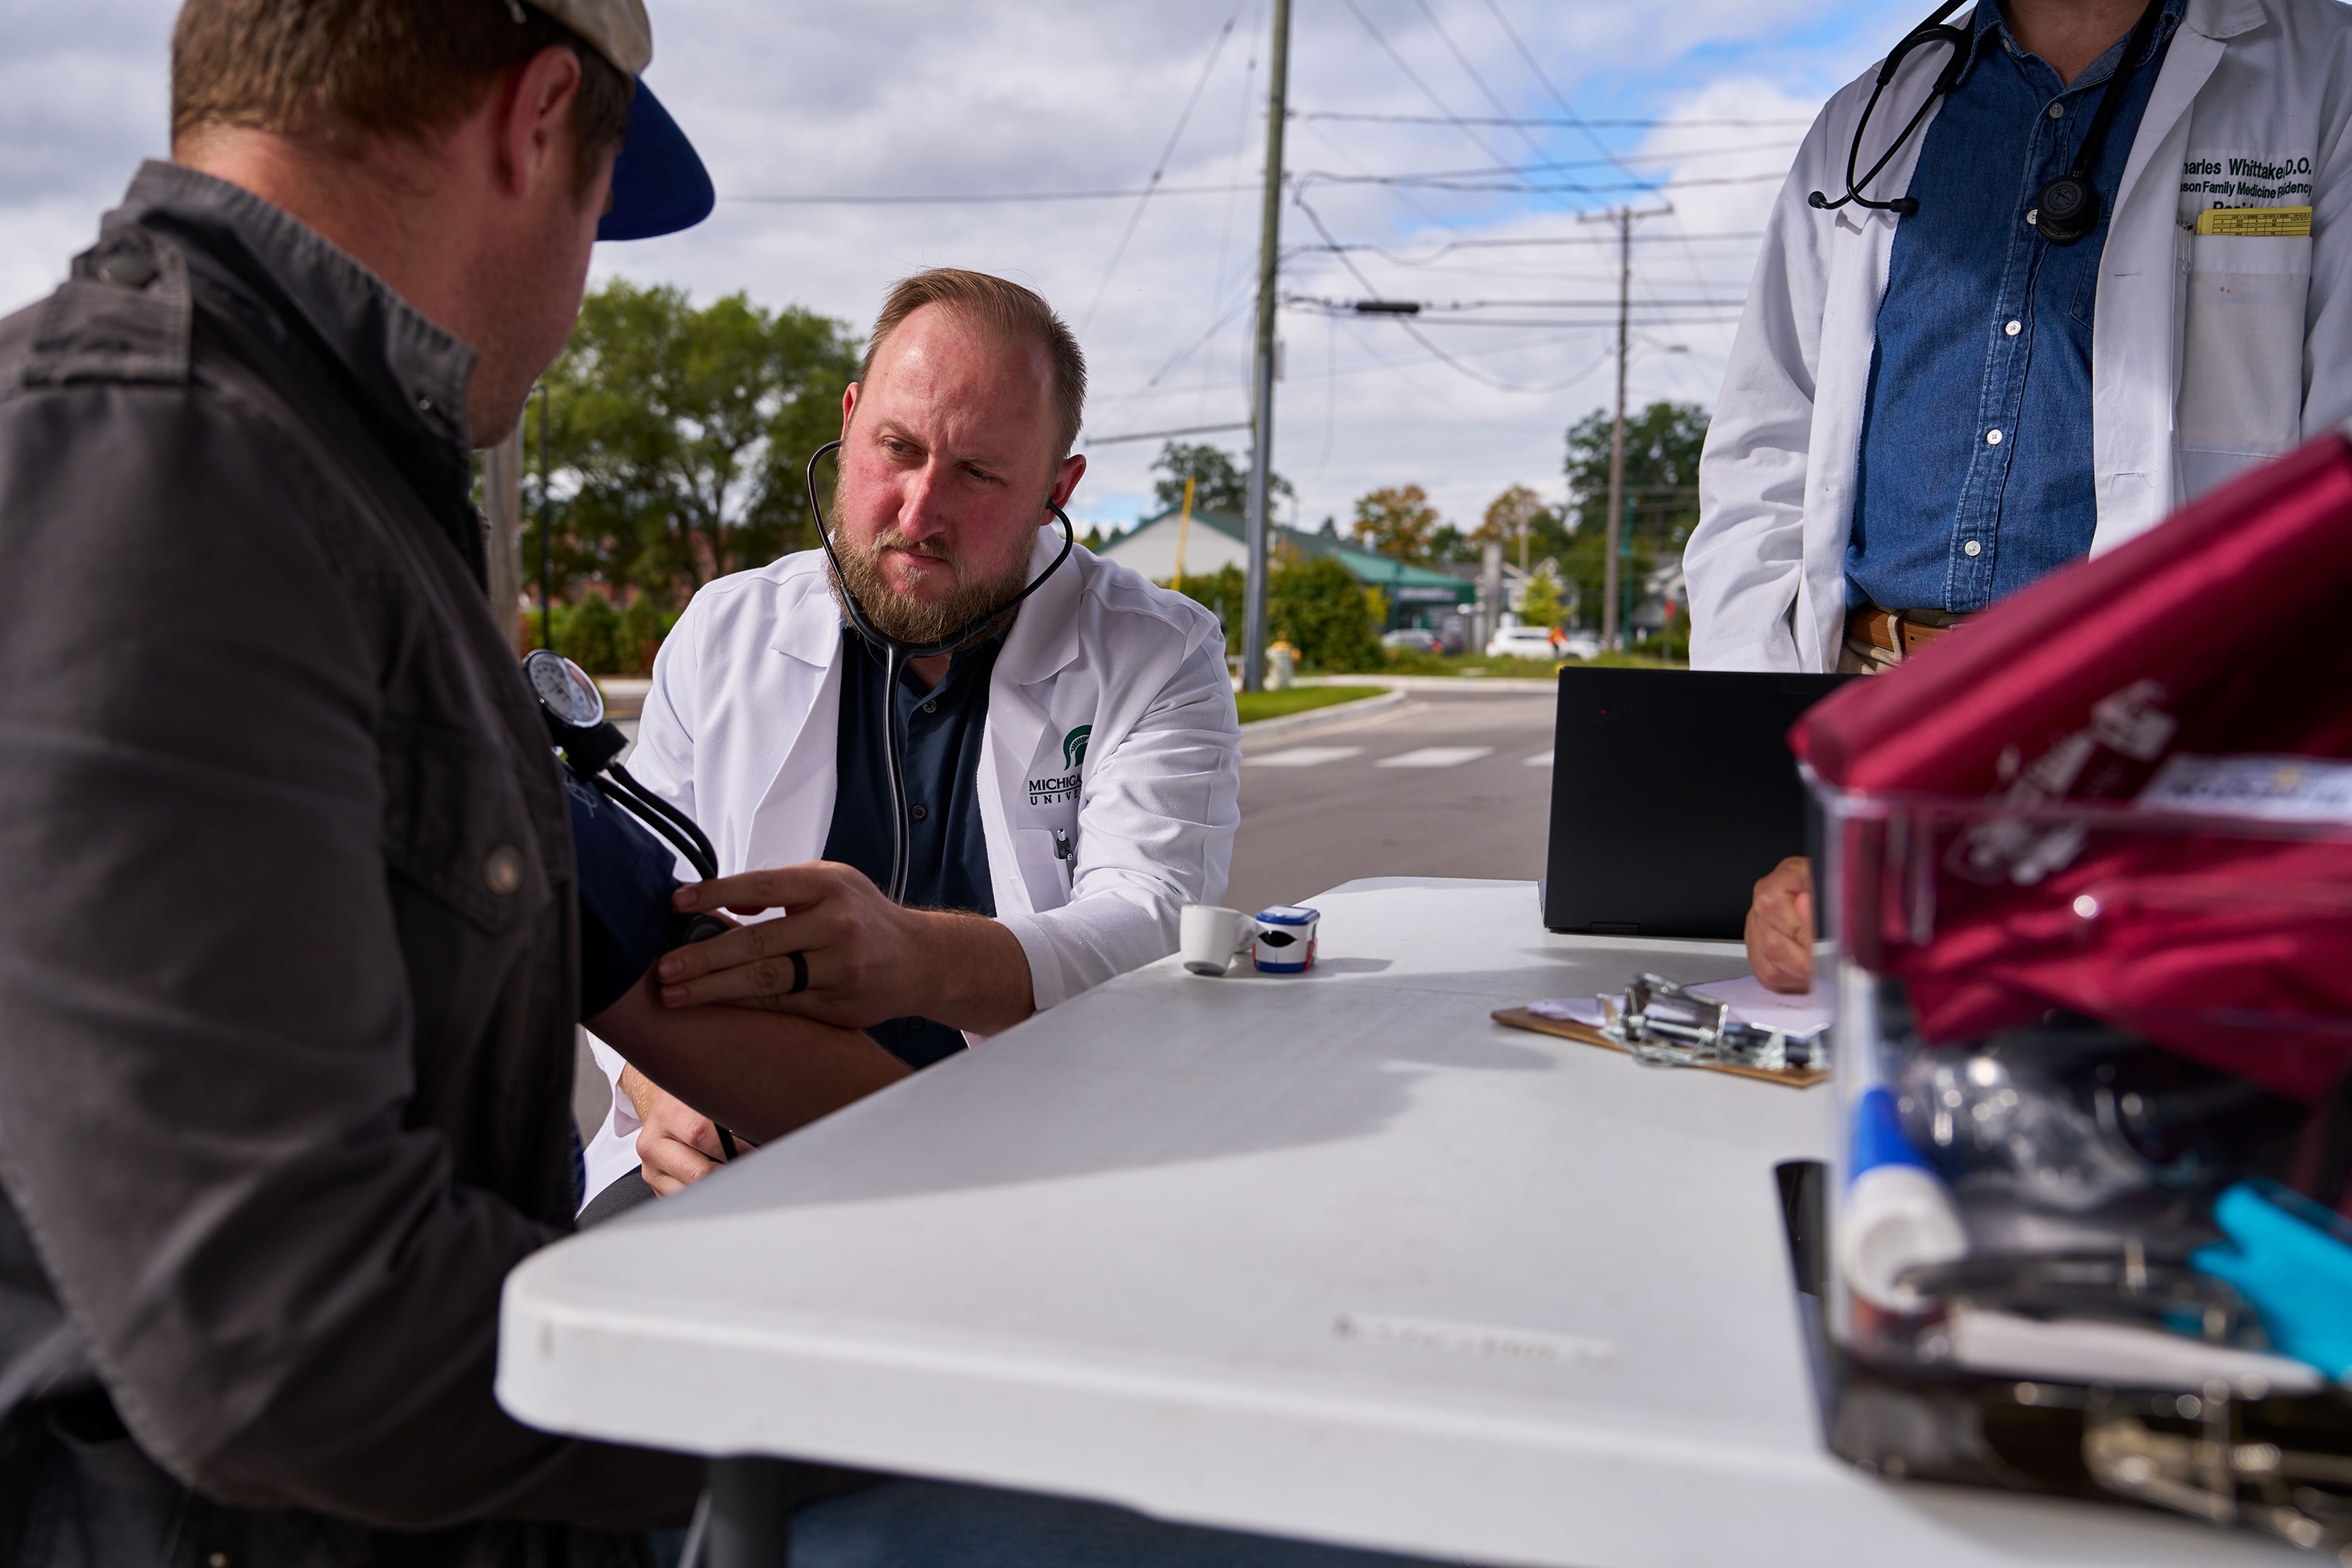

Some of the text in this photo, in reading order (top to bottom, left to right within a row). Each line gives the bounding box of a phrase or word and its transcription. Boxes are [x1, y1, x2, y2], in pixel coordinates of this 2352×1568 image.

[2229, 158, 2285, 180] Whittake
[2285, 157, 2312, 176] D.O.
[2203, 181, 2235, 197] Family
[2237, 182, 2276, 199] Medicine
[1029, 773, 1083, 792] MICHIGA
[1029, 789, 1081, 805] UNIVE
